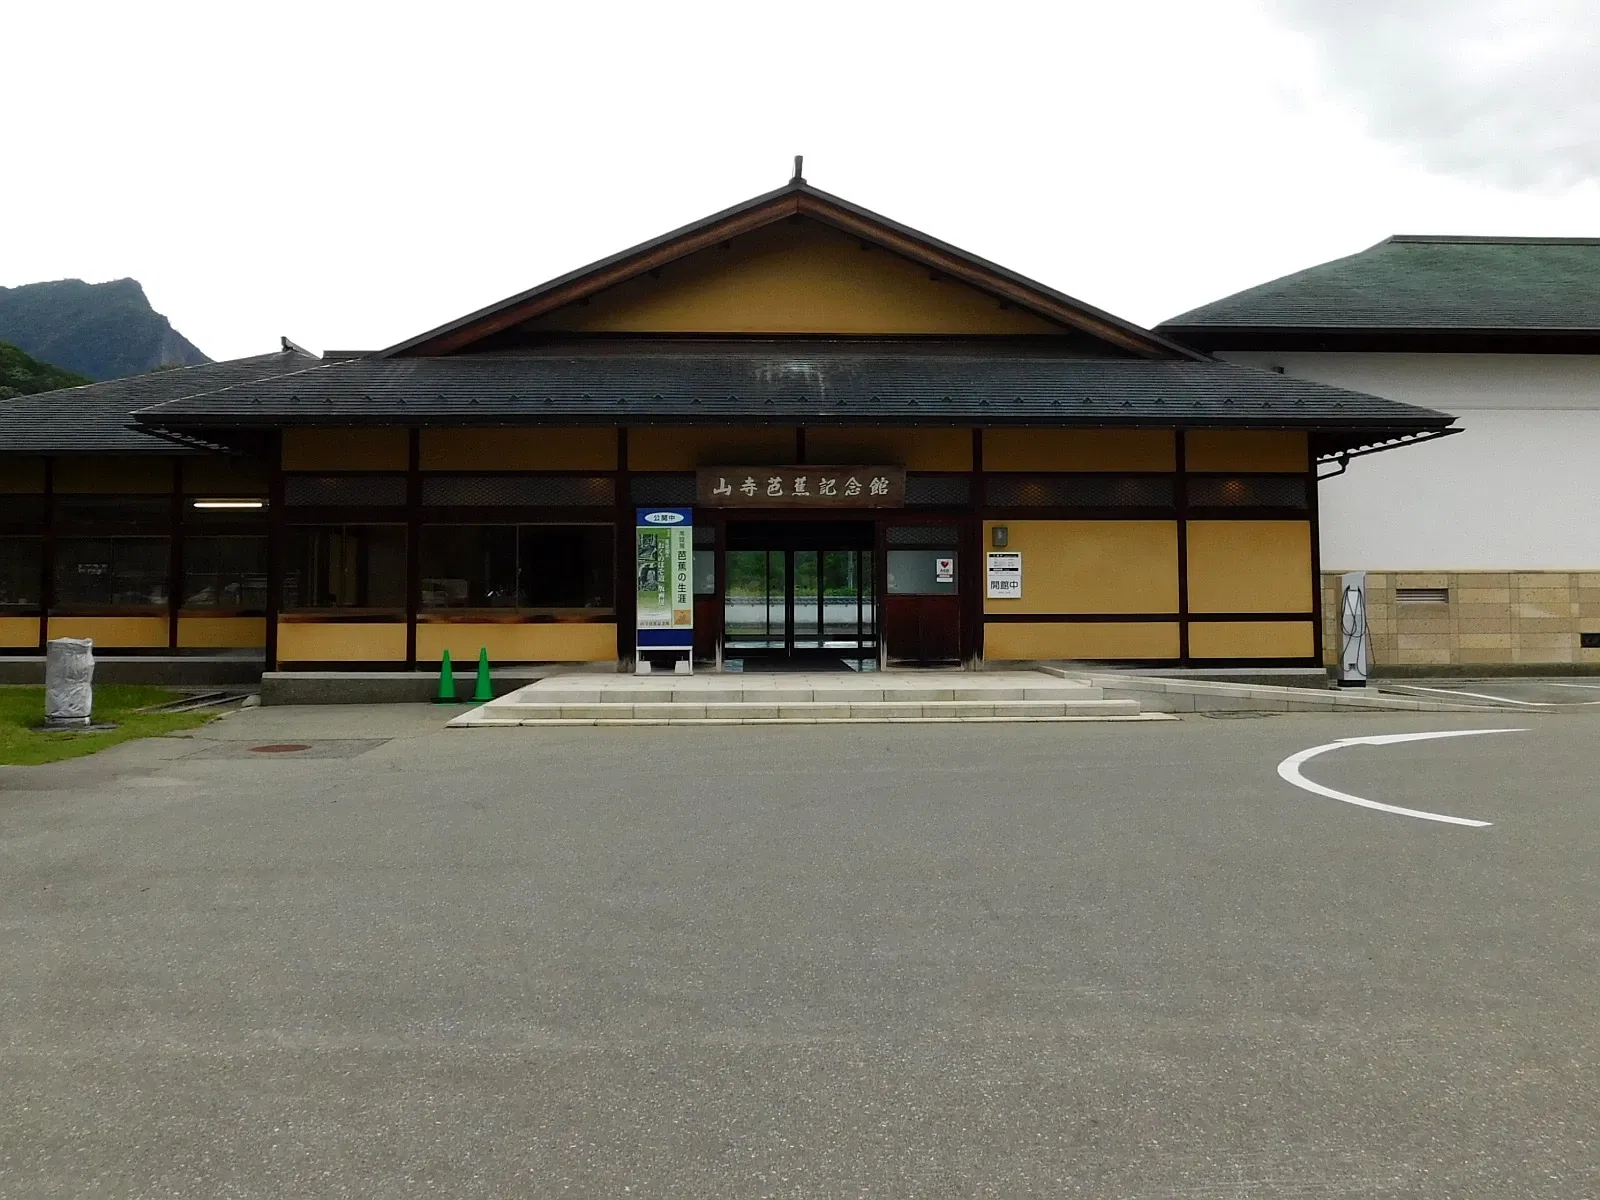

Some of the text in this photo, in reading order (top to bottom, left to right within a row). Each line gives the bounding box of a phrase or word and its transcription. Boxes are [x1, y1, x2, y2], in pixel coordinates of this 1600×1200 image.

[713, 476, 889, 496] 山寺芭蕉記念館
[677, 550, 687, 604] 芭蕉の生涯
[990, 580, 1019, 590] 開館中
